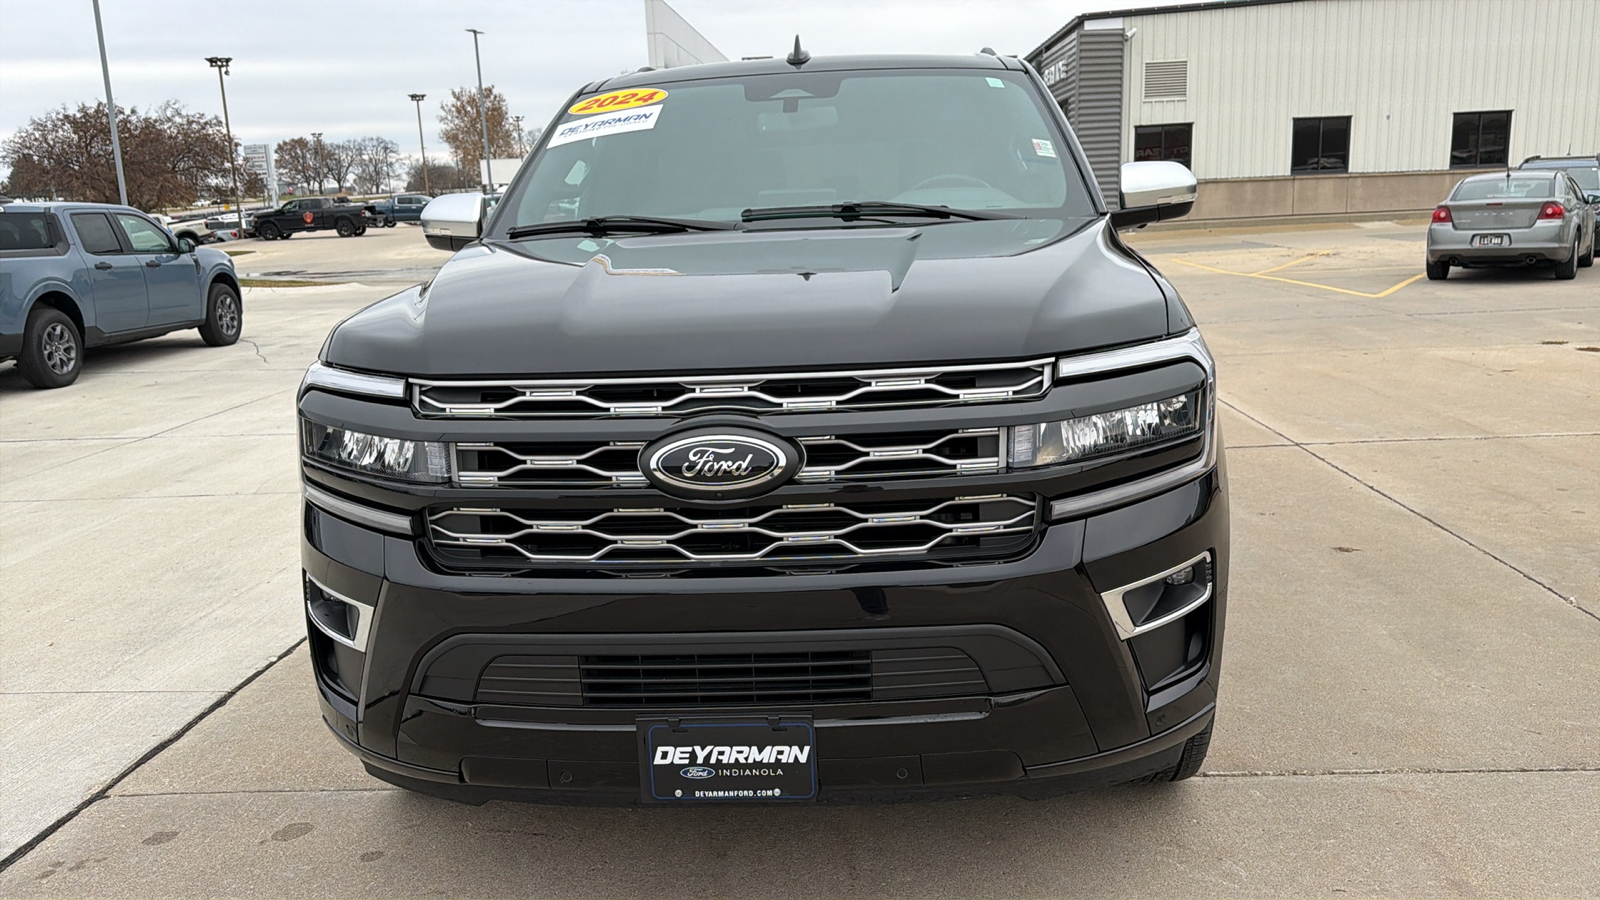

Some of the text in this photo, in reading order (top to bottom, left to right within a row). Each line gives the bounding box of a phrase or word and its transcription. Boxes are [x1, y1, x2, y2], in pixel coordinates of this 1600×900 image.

[576, 91, 660, 112] 2024
[559, 112, 654, 136] DEYARMAN
[681, 447, 754, 477] Ford
[653, 745, 811, 765] DEYARMAN
[718, 768, 784, 777] INDIANOLA
[695, 789, 773, 798] DEYARMANFORD.COM
